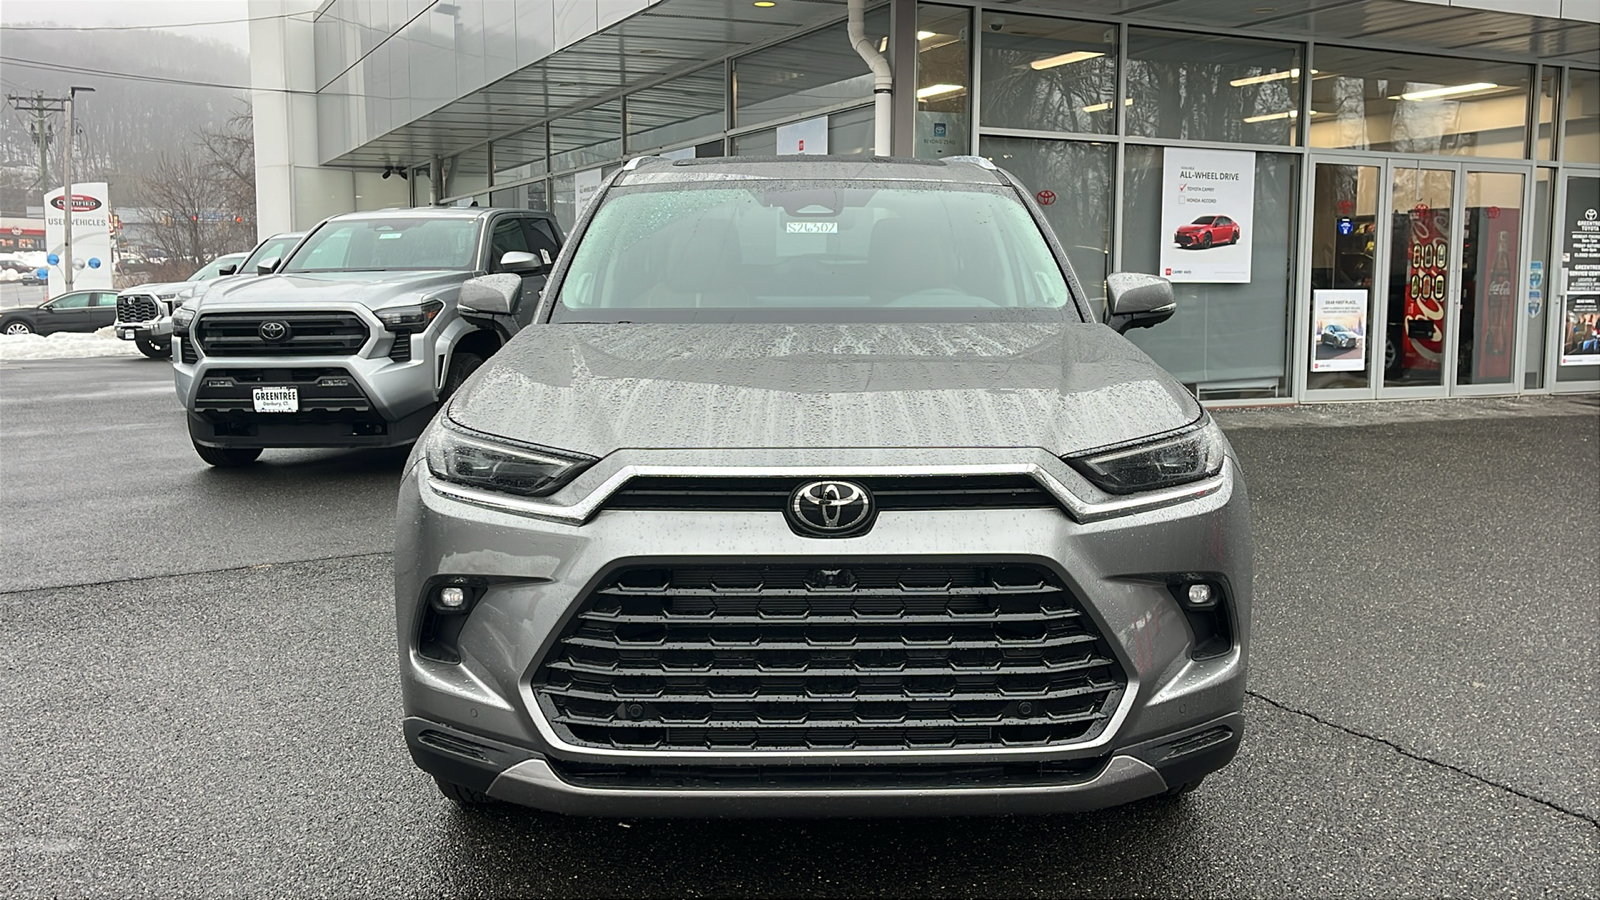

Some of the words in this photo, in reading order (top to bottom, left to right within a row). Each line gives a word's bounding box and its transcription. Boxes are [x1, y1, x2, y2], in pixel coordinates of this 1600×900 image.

[1179, 170, 1218, 180] ALL-WHEEL
[1219, 172, 1240, 181] DRIVE
[48, 218, 66, 226] USE
[71, 218, 106, 227] VEHICLES
[255, 391, 296, 400] GREENTREE
